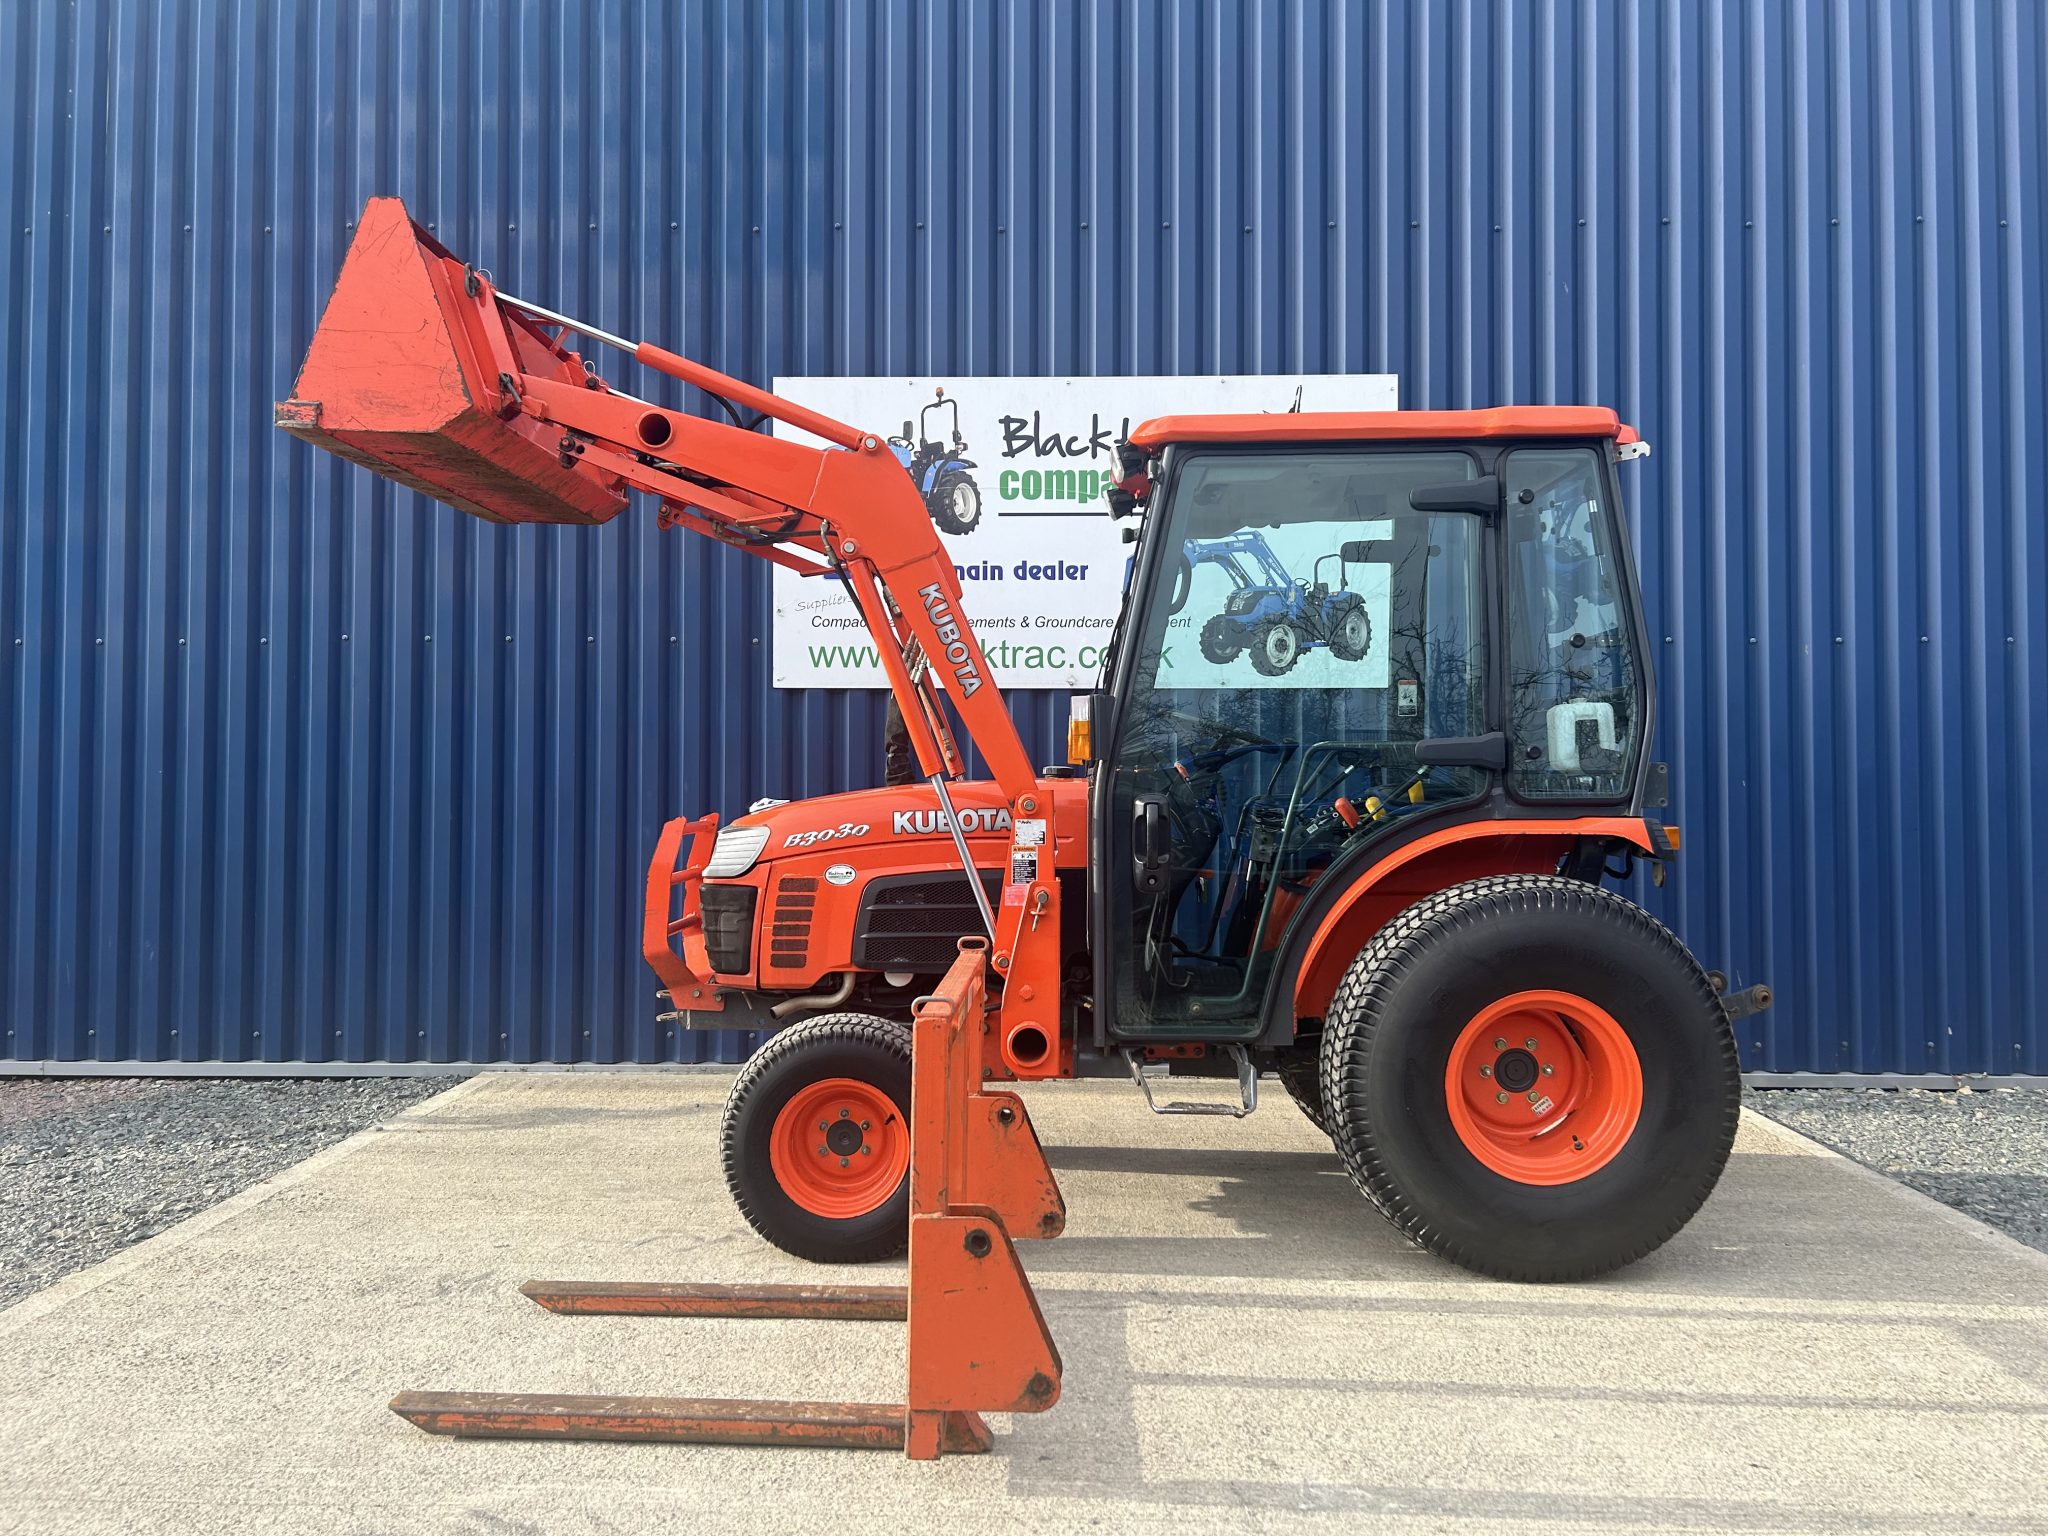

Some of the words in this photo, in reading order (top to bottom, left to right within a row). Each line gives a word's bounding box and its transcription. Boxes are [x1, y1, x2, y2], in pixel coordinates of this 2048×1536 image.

[999, 469, 1118, 504] compa
[1013, 560, 1088, 581] dealer
[811, 615, 867, 630] Compac
[967, 616, 1016, 628] ements
[1020, 615, 1030, 628] &
[1035, 615, 1114, 628] Groundcare
[917, 581, 984, 700] KUBOTA
[783, 822, 870, 848] B3030
